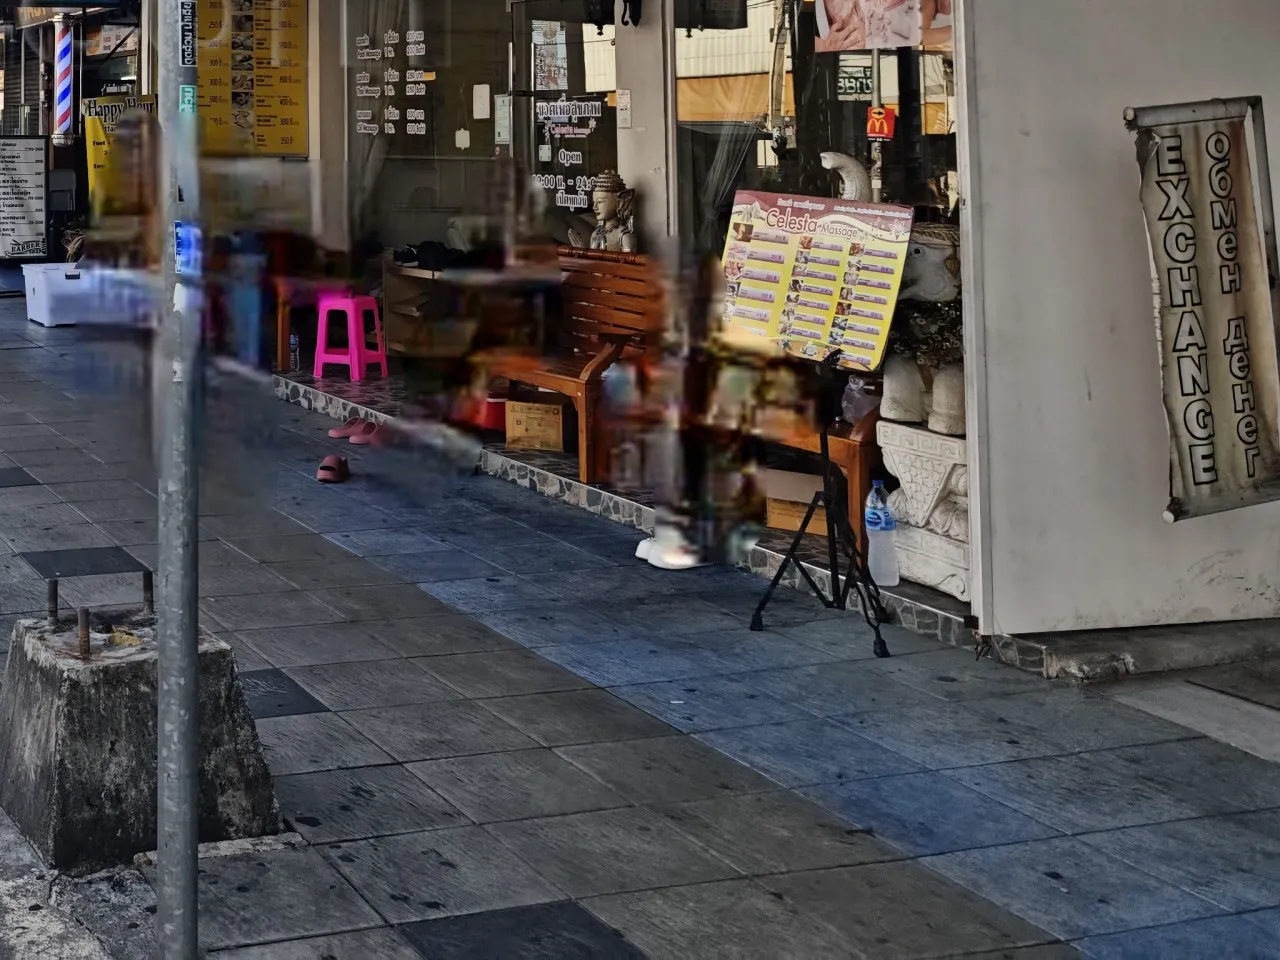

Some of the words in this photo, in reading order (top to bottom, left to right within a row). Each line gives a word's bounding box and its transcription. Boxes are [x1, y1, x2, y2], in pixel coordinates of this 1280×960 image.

[87, 99, 125, 123] Happy
[559, 149, 582, 166] Open
[766, 208, 818, 234] Celesta
[821, 222, 859, 240] Massage
[1155, 135, 1218, 486] EXCHANGE
